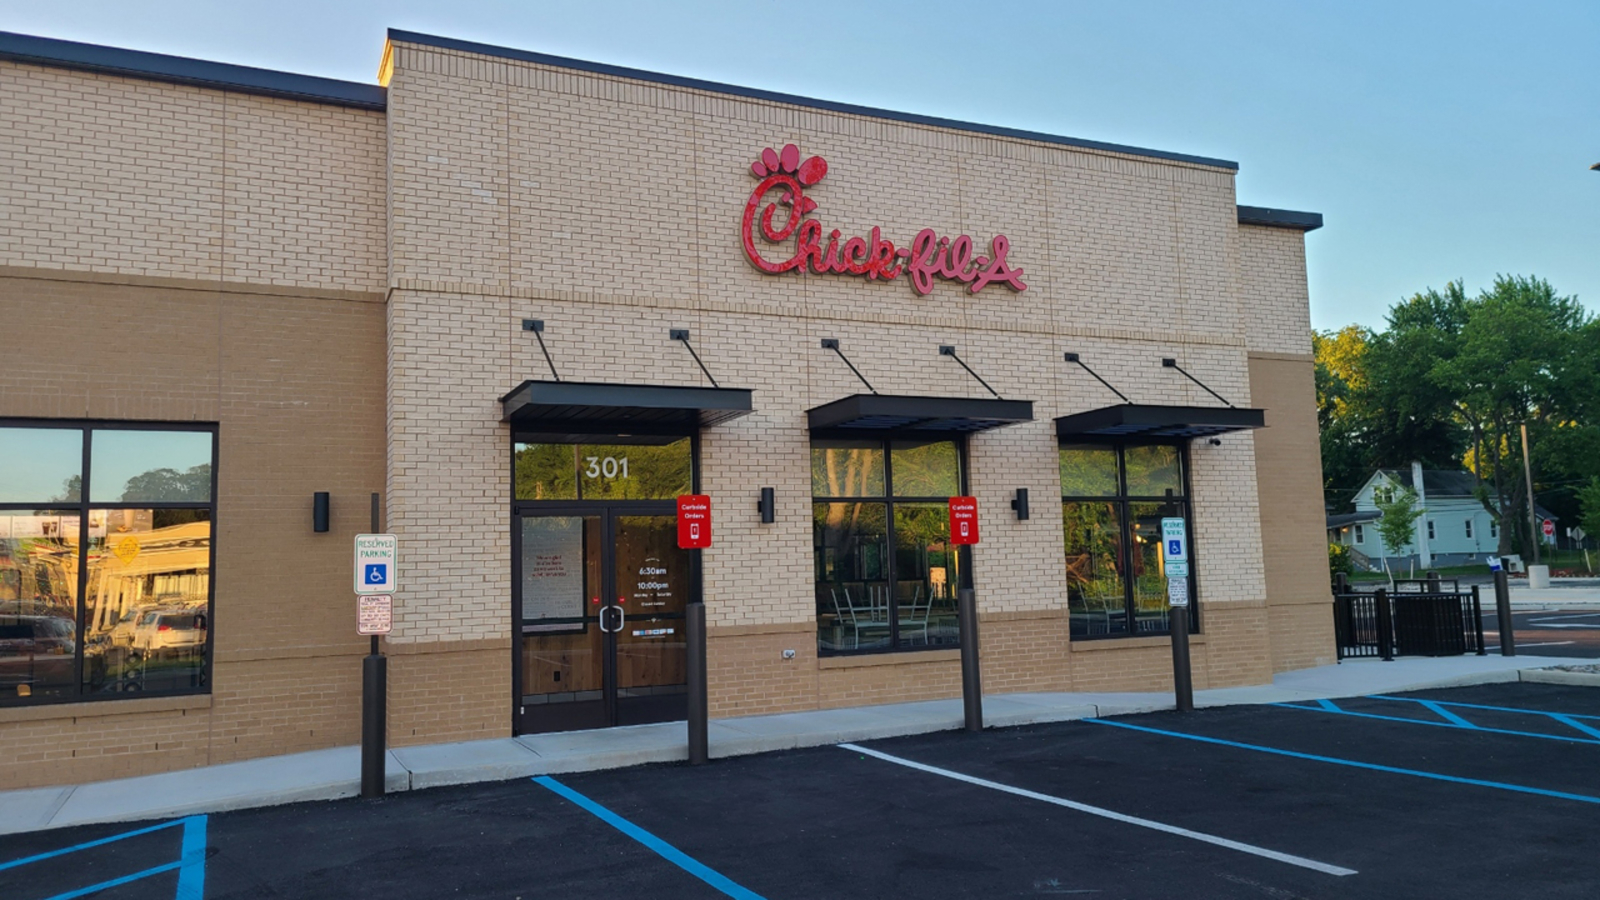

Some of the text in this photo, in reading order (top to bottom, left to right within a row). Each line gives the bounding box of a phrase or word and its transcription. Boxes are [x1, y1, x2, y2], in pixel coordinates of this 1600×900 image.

[740, 143, 1028, 296] Chick-fil-A
[585, 456, 628, 479] 301
[684, 512, 705, 520] Orders
[358, 540, 394, 548] RESERVED
[360, 550, 392, 558] PARKING
[639, 567, 667, 575] 6:30am
[637, 582, 669, 590] 10:00pm
